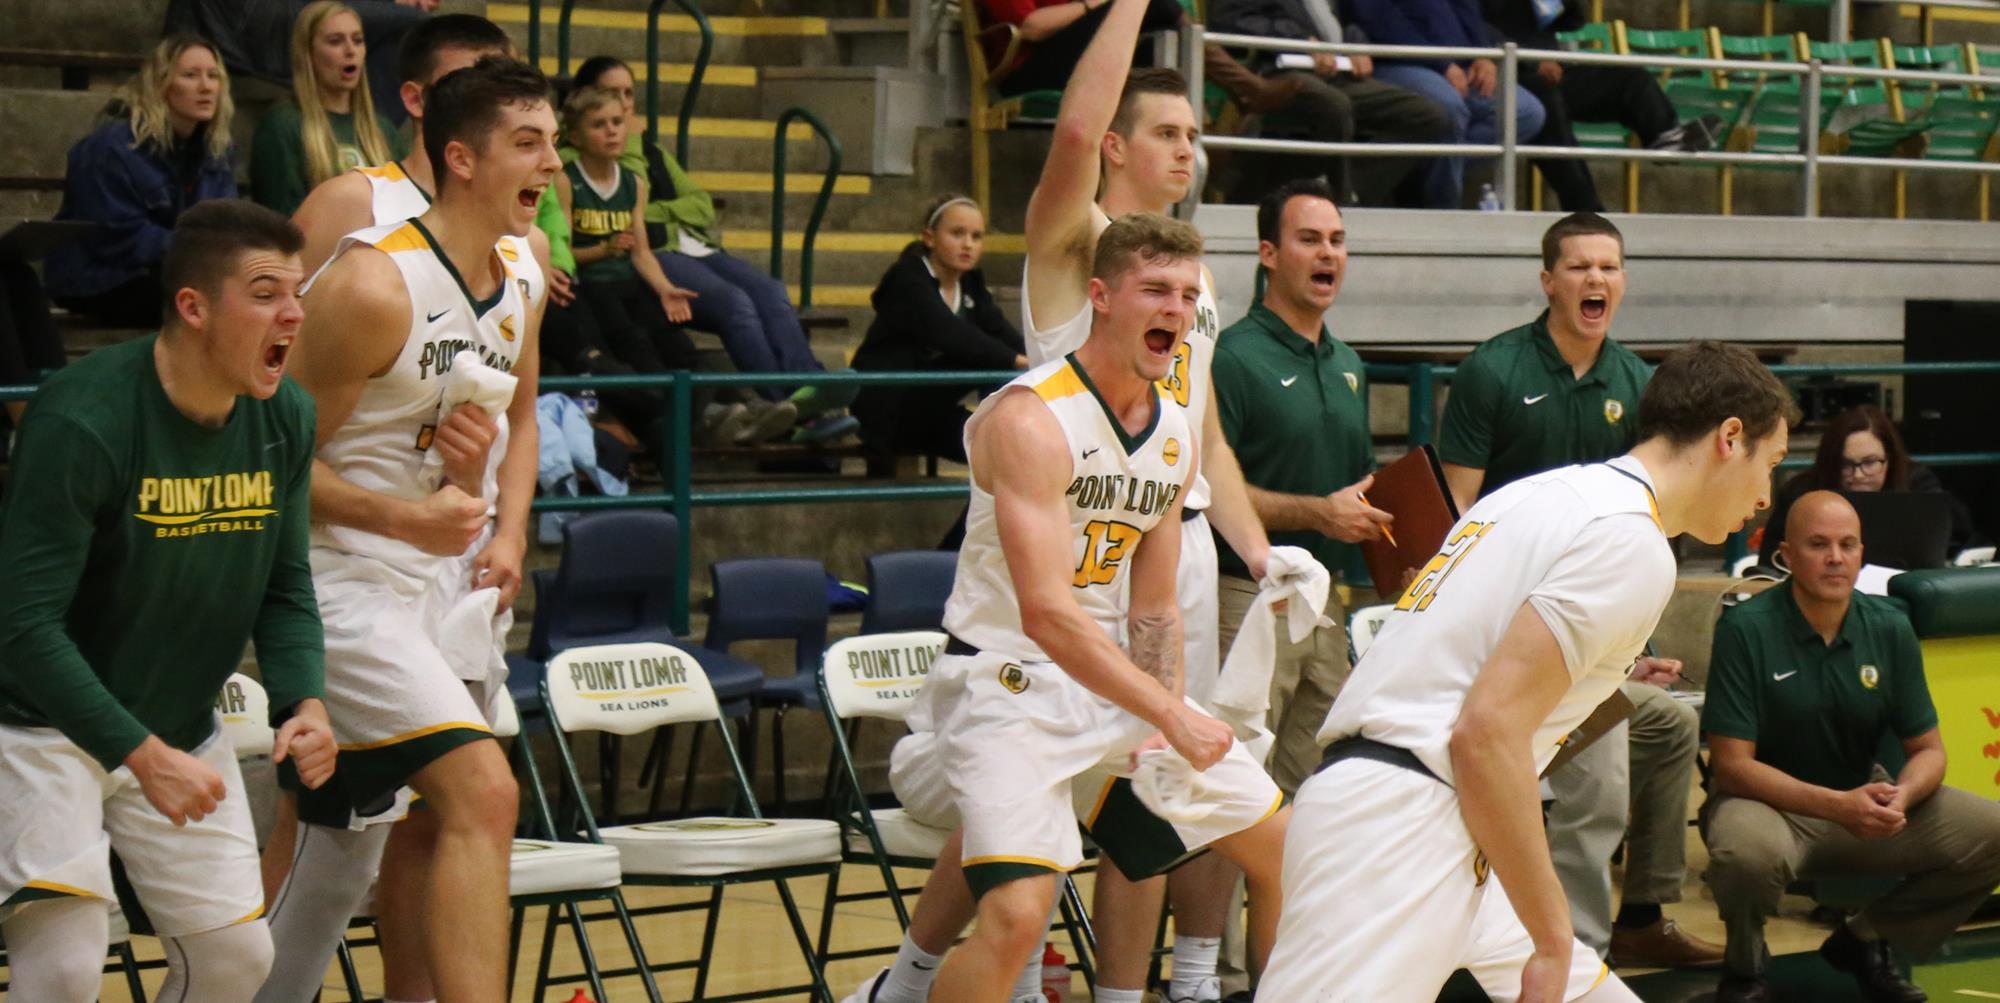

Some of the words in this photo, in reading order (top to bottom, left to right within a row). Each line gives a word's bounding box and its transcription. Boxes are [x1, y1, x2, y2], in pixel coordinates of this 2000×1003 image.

[138, 476, 213, 514] POINT
[155, 519, 265, 539] BASKETBALL
[1072, 519, 1142, 589] 12
[1392, 520, 1498, 614] 21
[568, 660, 626, 691] POINT
[628, 655, 688, 689] LOMA
[847, 648, 902, 679] POINT
[599, 702, 624, 712] SEA
[627, 698, 669, 711] LIONS
[875, 690, 900, 700] SEA
